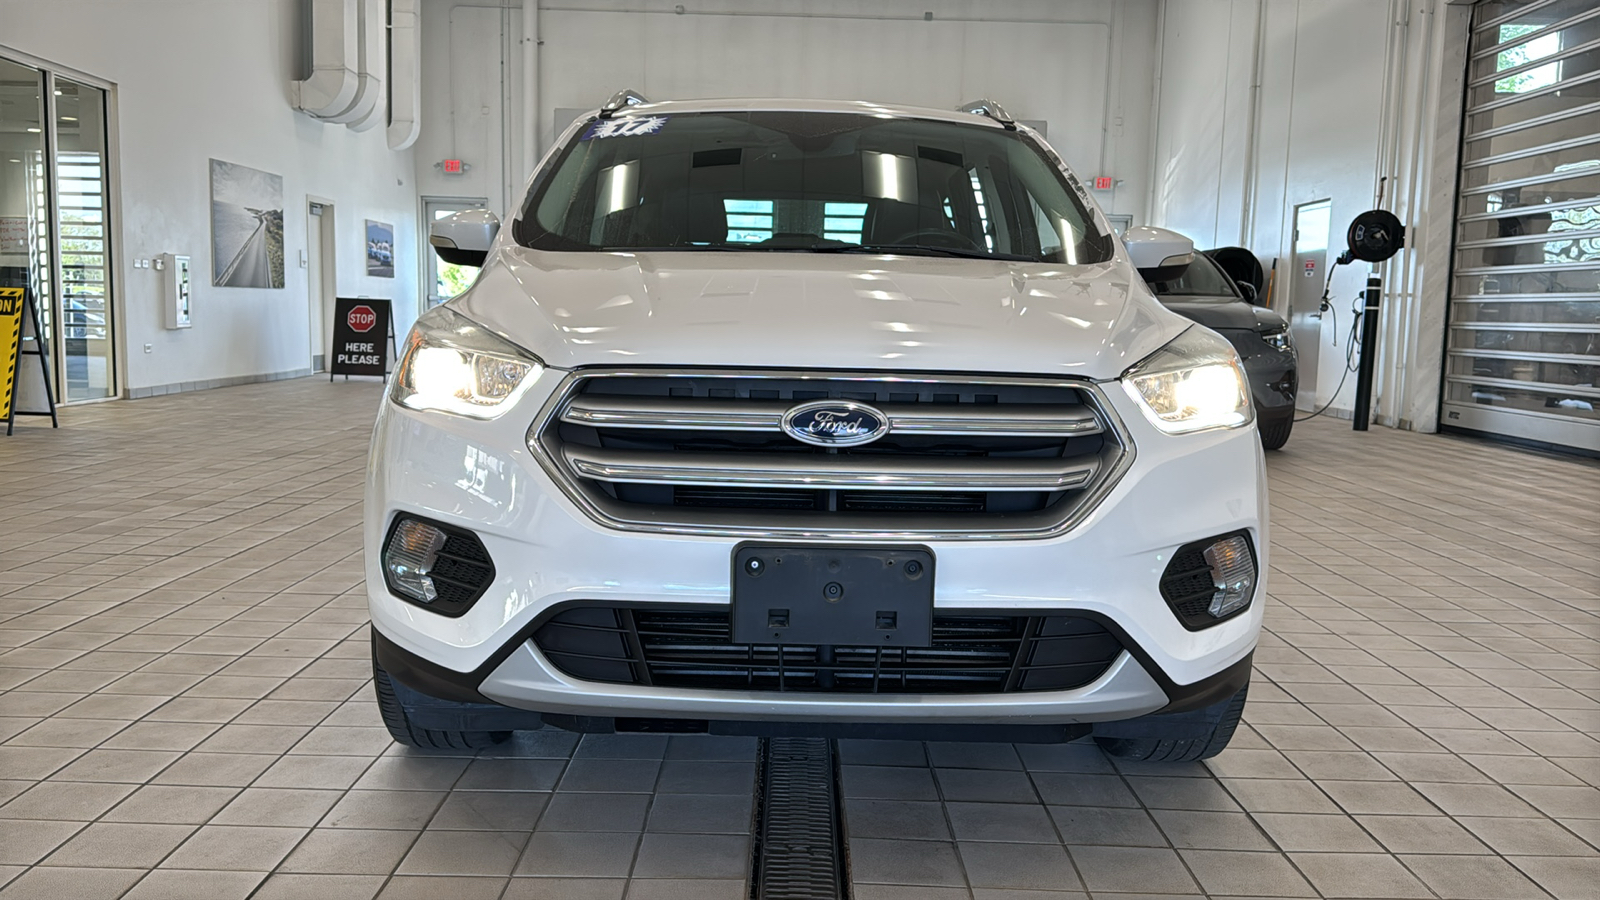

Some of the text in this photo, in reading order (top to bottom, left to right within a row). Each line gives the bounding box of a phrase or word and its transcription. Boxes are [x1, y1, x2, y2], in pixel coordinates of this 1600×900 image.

[445, 159, 460, 172] EXIT
[1096, 177, 1112, 189] EXIT
[349, 313, 374, 324] STOP
[345, 342, 374, 352] HERE
[337, 353, 380, 365] PLEASE
[808, 410, 863, 433] Ford
